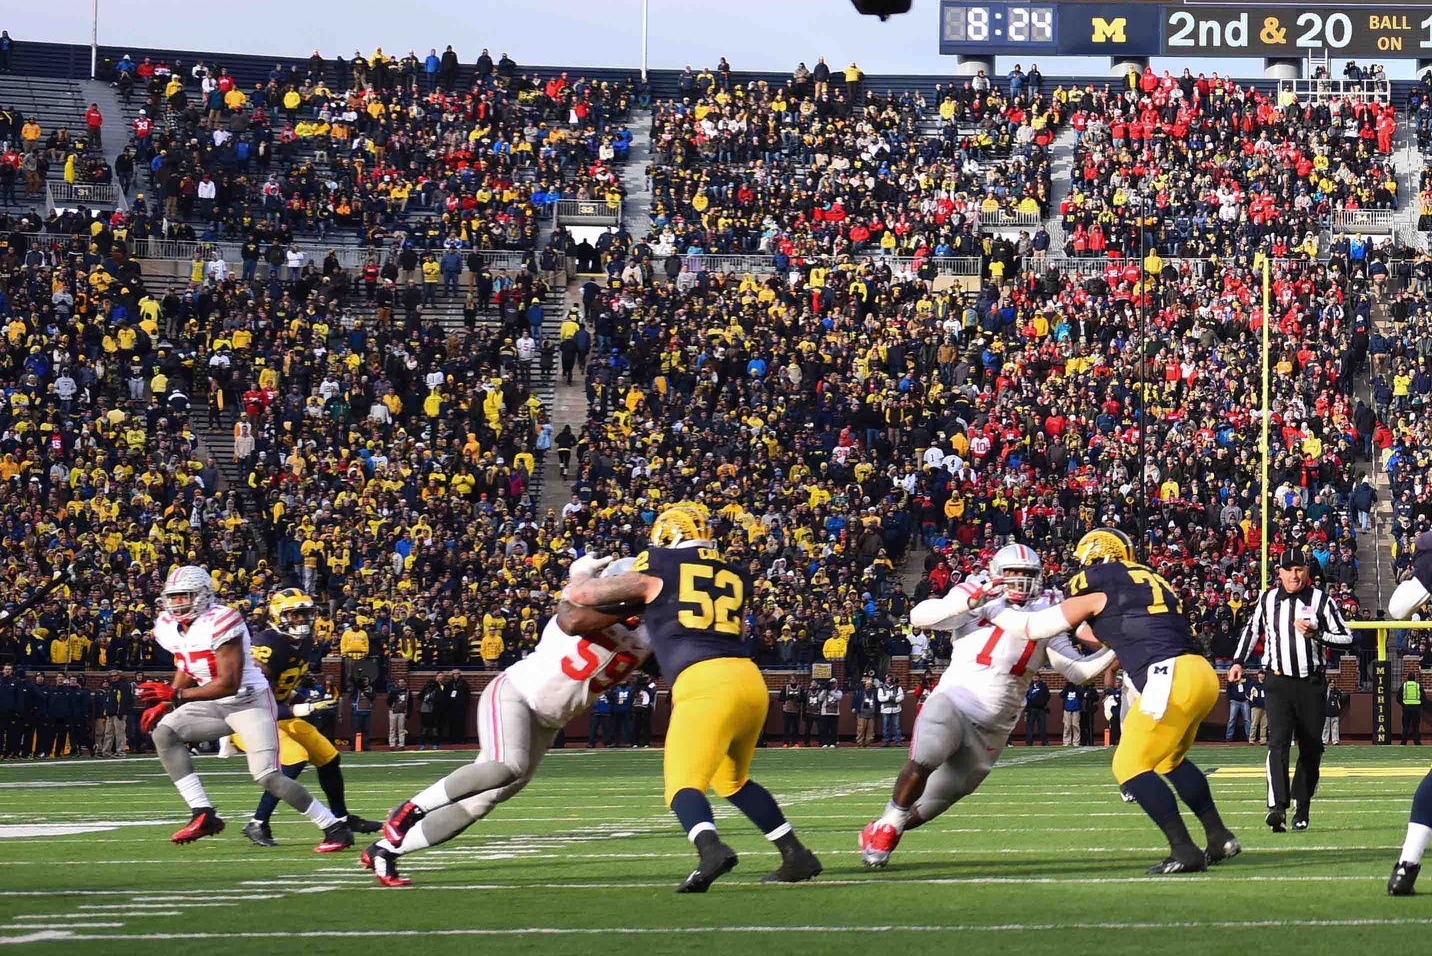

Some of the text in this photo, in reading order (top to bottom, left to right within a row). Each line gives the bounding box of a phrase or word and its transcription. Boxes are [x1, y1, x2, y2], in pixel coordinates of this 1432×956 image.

[967, 7, 1052, 41] 8:24
[1369, 15, 1411, 30] BALL
[1092, 17, 1126, 43] M
[1168, 11, 1353, 48] 2nd & 20
[1377, 36, 1402, 51] ON
[137, 122, 148, 130] 33
[77, 188, 89, 196] 31
[580, 205, 594, 214] 32
[1355, 214, 1368, 222] 34
[975, 442, 987, 452] 10
[950, 459, 956, 467] 4
[678, 563, 744, 635] 52
[25, 643, 32, 655] 4
[561, 632, 638, 693] 59
[1153, 666, 1168, 675] M
[1375, 666, 1386, 742] MICHIGAN
